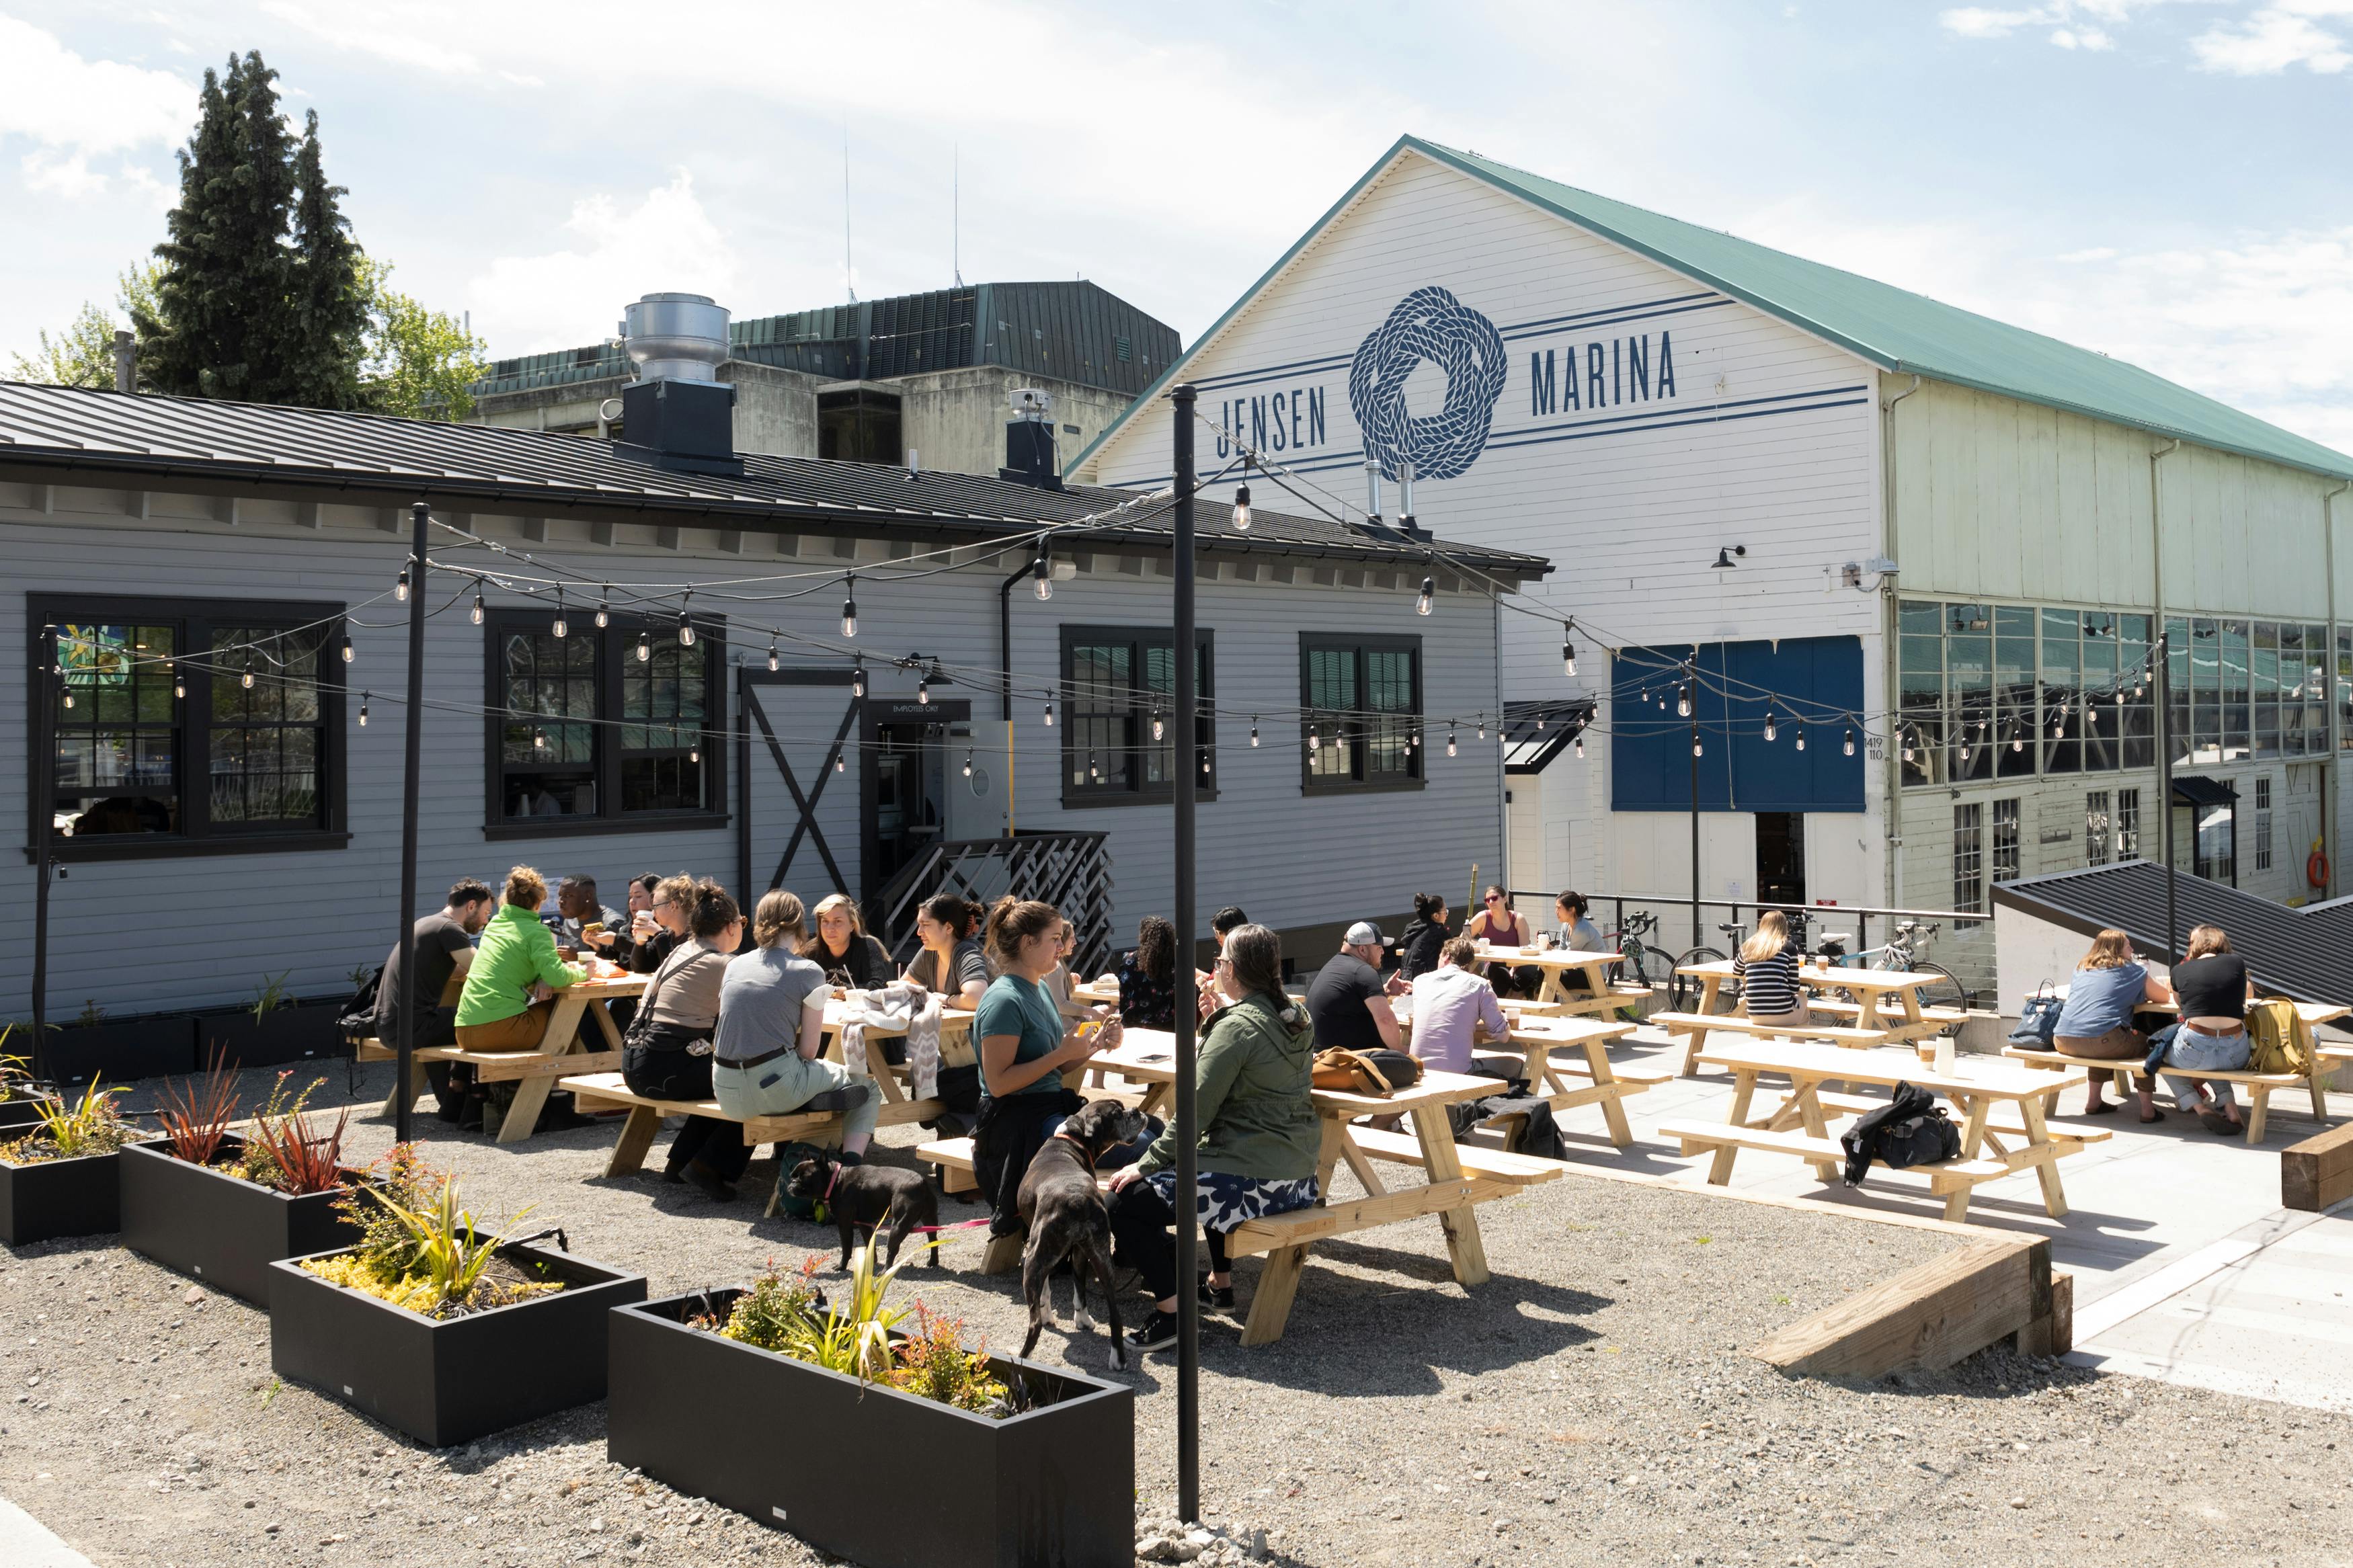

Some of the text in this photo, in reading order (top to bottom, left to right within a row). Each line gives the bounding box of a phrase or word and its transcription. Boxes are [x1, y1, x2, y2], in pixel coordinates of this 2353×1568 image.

[1217, 331, 1676, 458] JENSEN MARINA
[1864, 737, 1882, 747] 1419
[1870, 749, 1882, 759] 110
